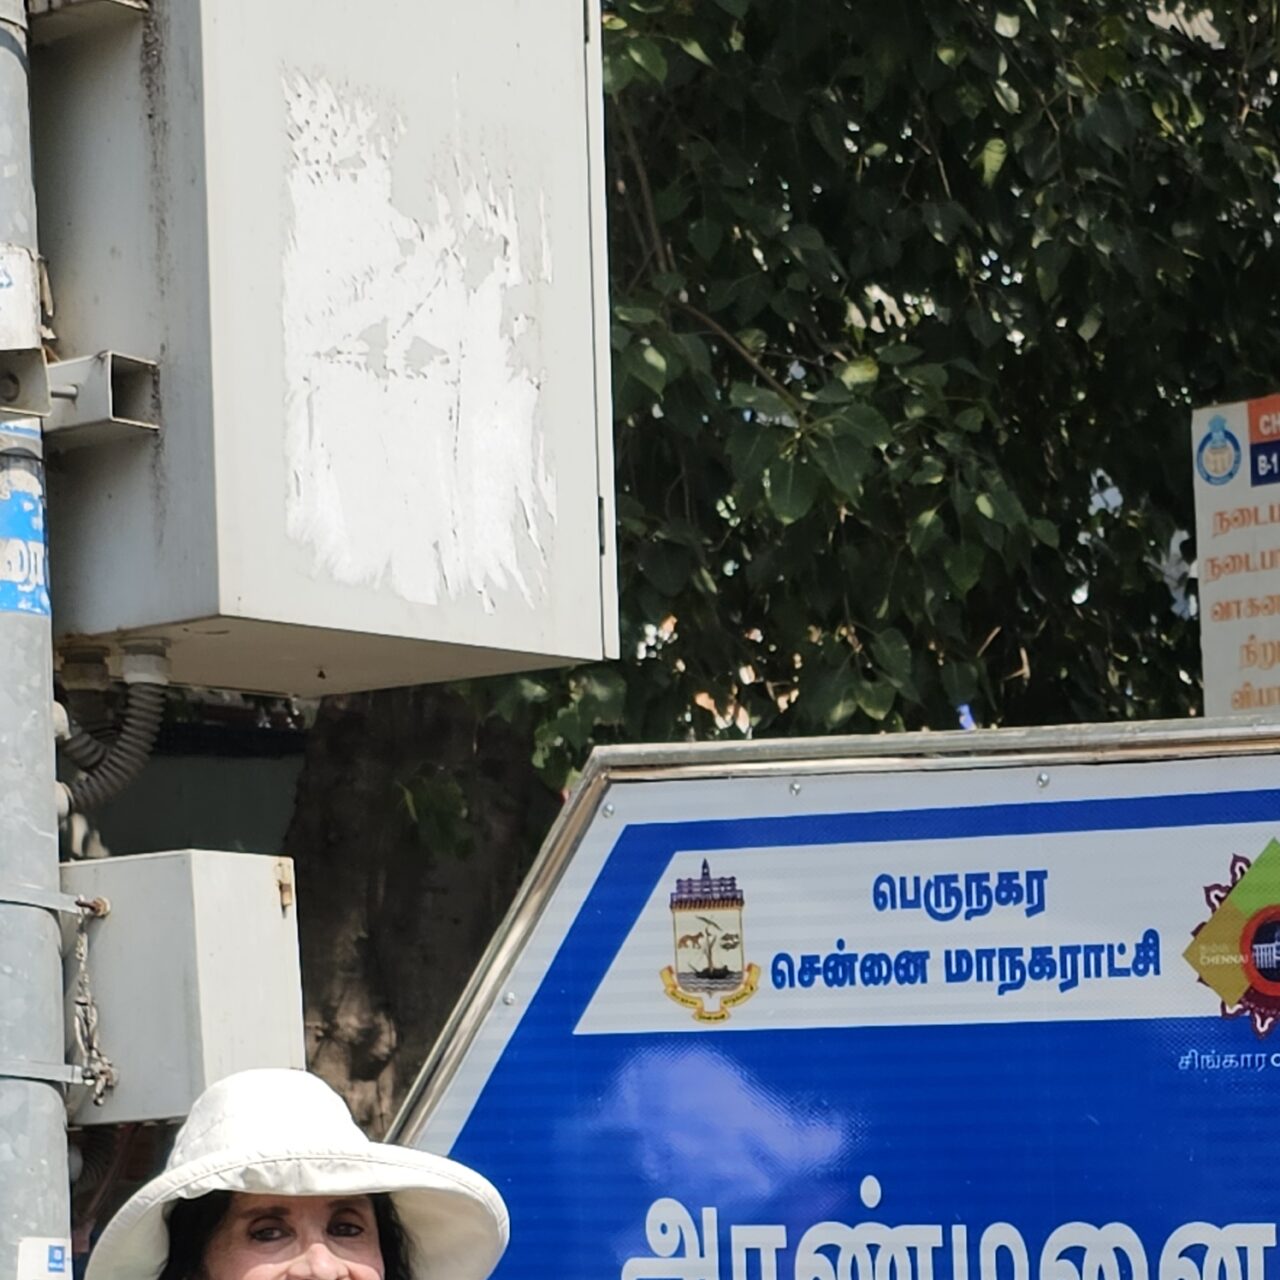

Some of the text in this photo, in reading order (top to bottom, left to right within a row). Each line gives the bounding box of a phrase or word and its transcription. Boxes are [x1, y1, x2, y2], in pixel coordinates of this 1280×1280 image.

[1257, 451, 1280, 476] B-1
[873, 870, 1048, 921] பெருநகர
[771, 929, 1160, 995] சென்னை மாநகராட்சி
[1178, 1050, 1267, 1072] சிங்கார
